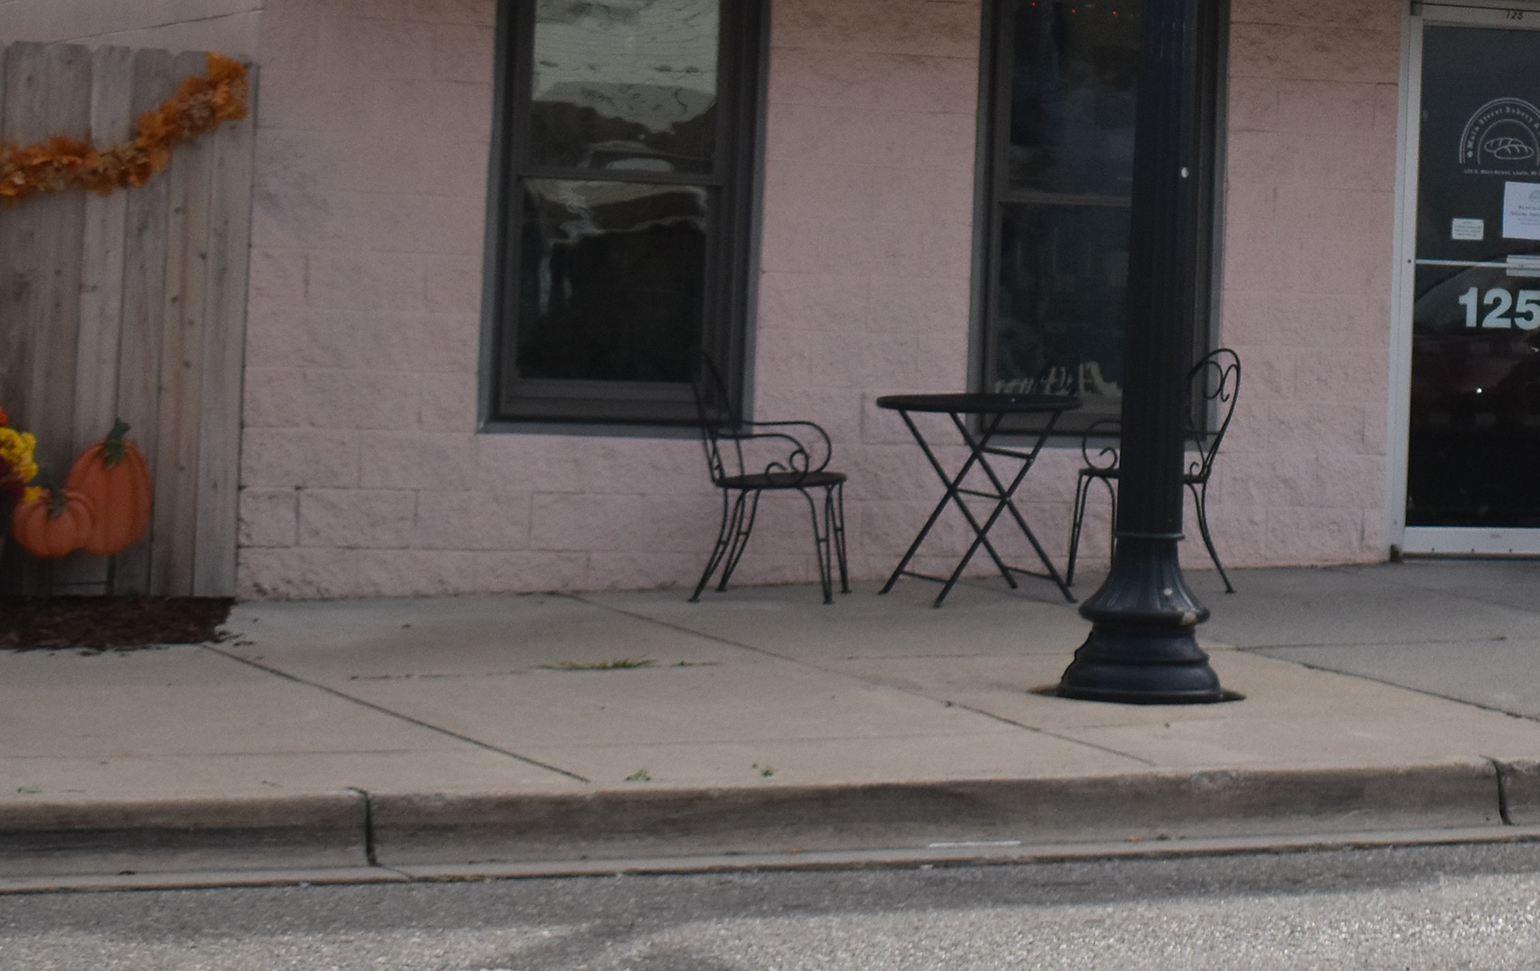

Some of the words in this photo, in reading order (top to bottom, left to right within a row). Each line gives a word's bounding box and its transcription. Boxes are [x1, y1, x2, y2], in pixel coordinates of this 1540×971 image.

[1507, 10, 1523, 20] 125
[1467, 126, 1480, 149] Main
[1478, 109, 1503, 125] Street
[1506, 106, 1534, 123] Bakery
